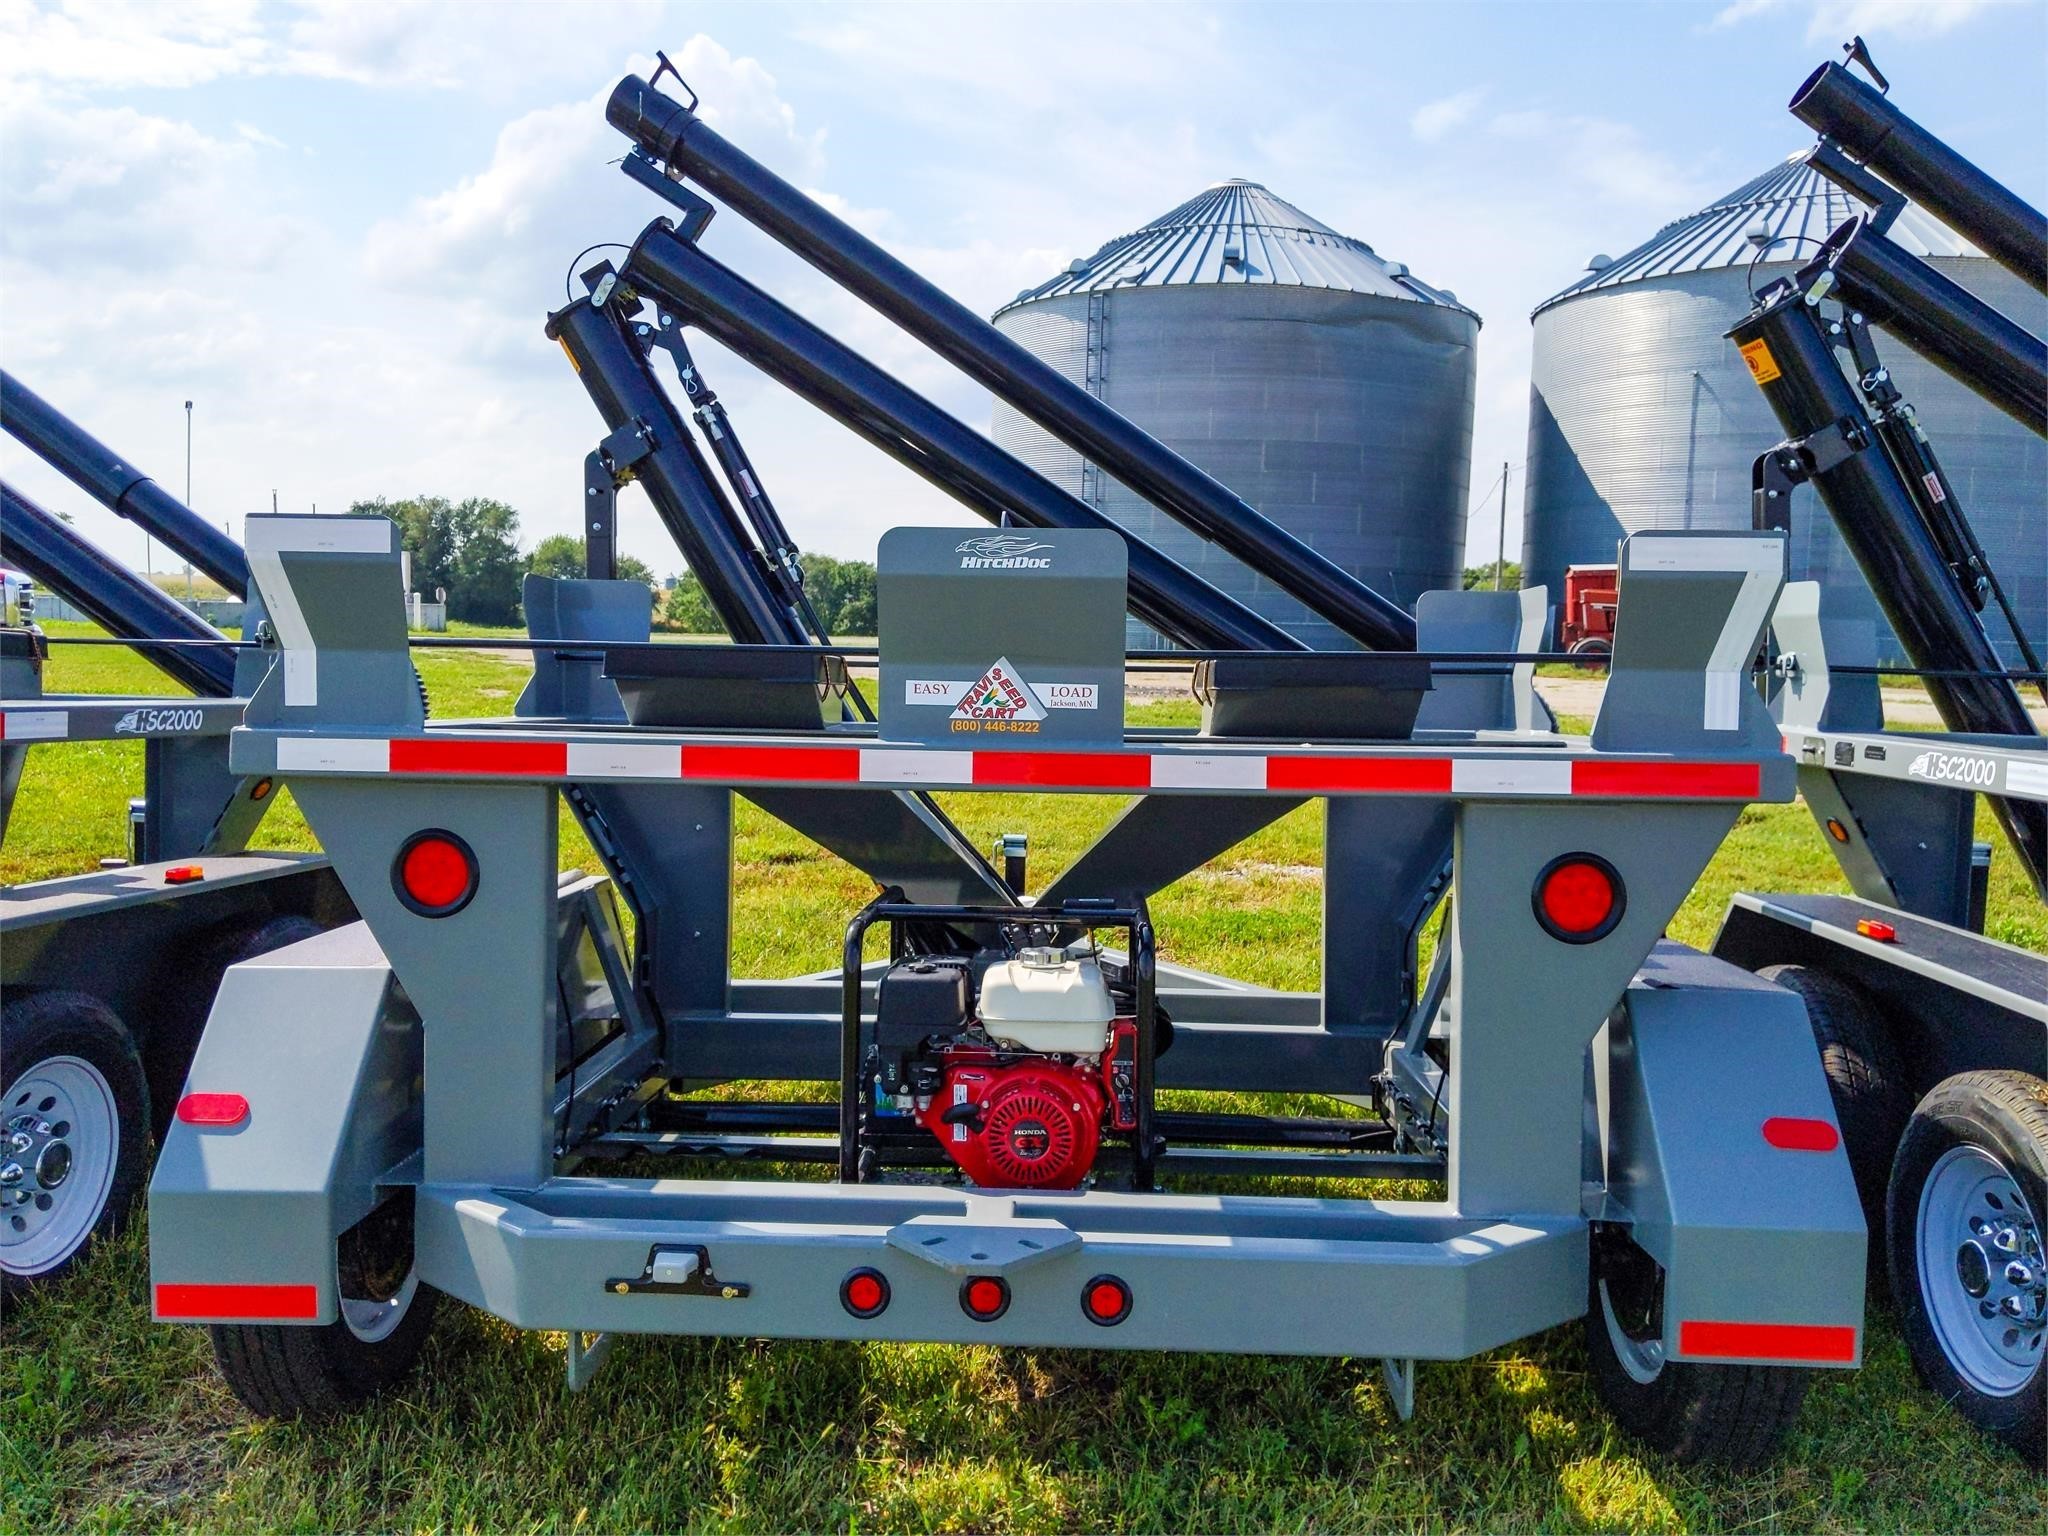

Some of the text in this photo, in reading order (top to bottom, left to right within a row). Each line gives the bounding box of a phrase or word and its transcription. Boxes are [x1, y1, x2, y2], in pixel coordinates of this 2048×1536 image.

[914, 684, 1093, 698] EASY LOAD
[971, 707, 1019, 719] CART
[951, 720, 1040, 733] (800) 446-8222
